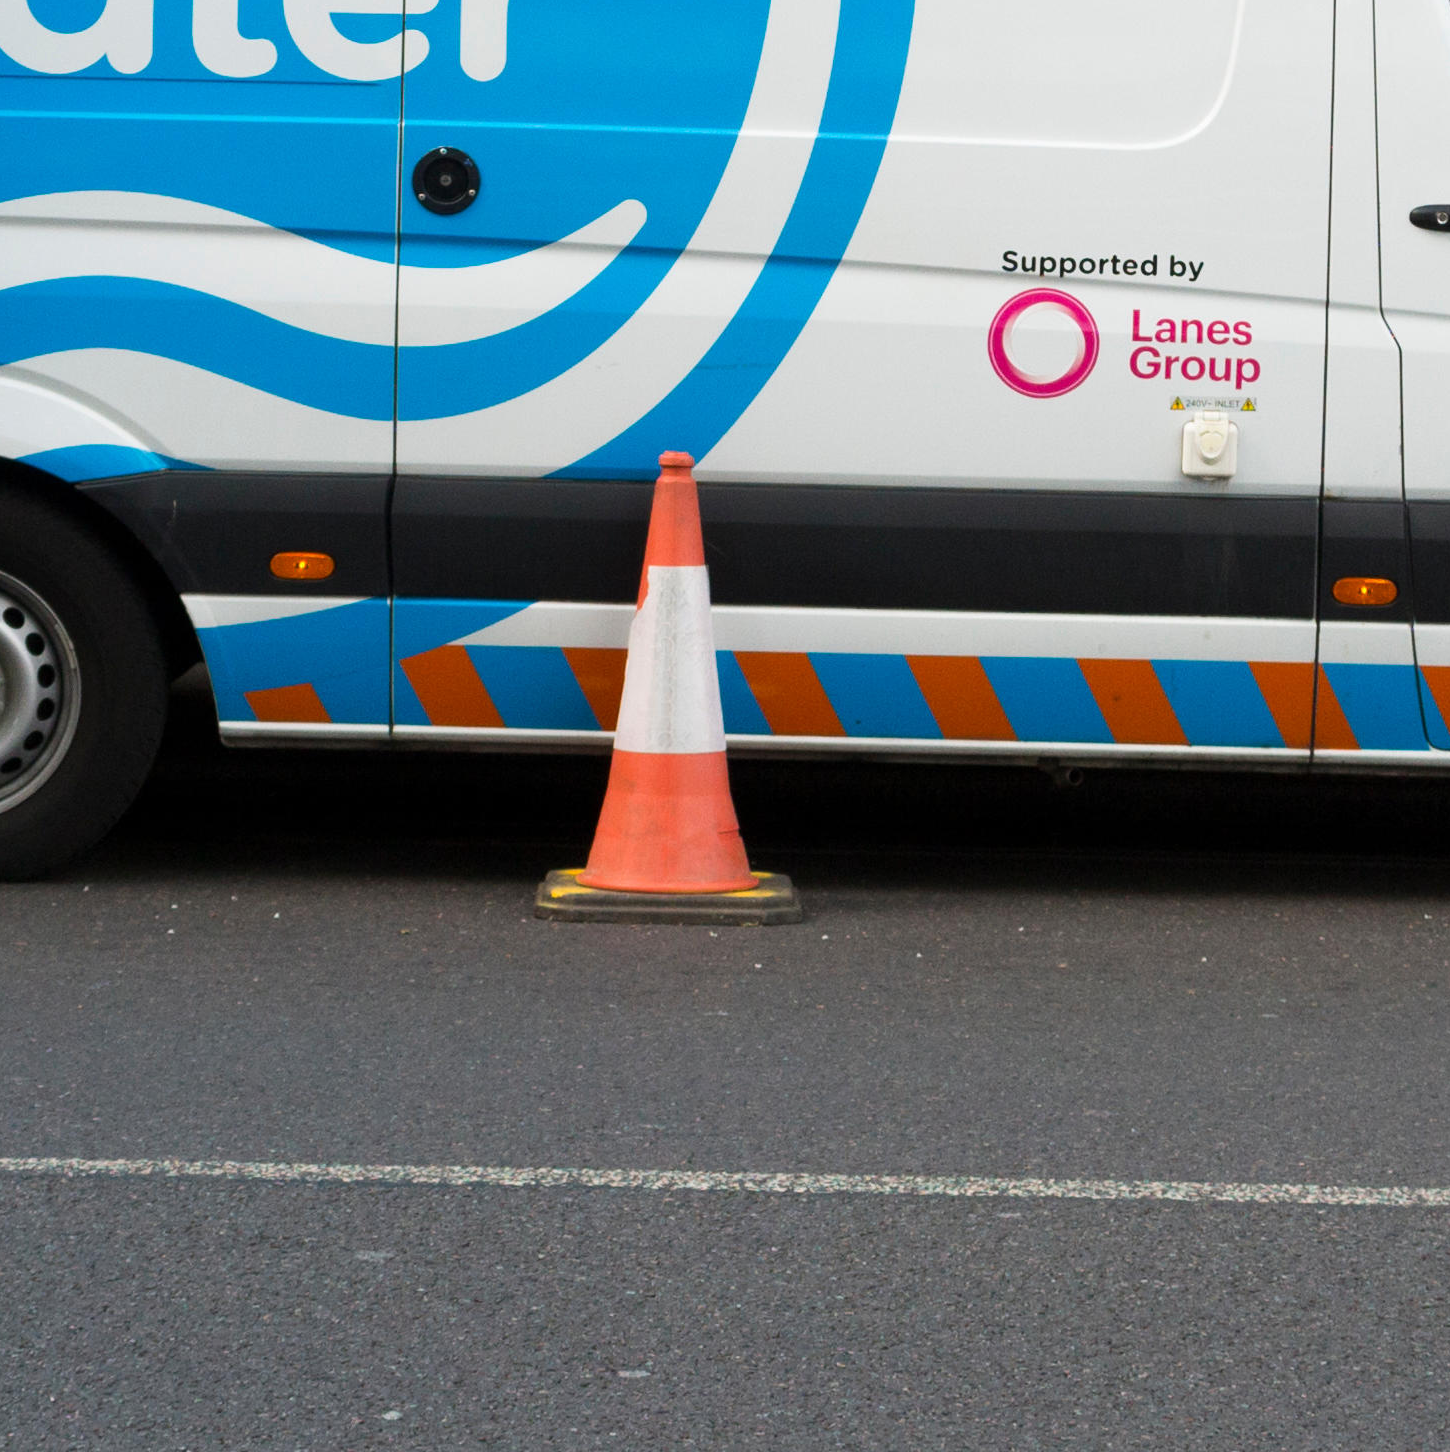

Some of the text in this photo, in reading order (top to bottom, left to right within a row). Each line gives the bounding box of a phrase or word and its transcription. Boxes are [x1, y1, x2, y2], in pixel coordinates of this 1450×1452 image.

[1002, 250, 1204, 281] Supported by
[1131, 309, 1253, 345] Lanes
[1129, 346, 1261, 390] Group
